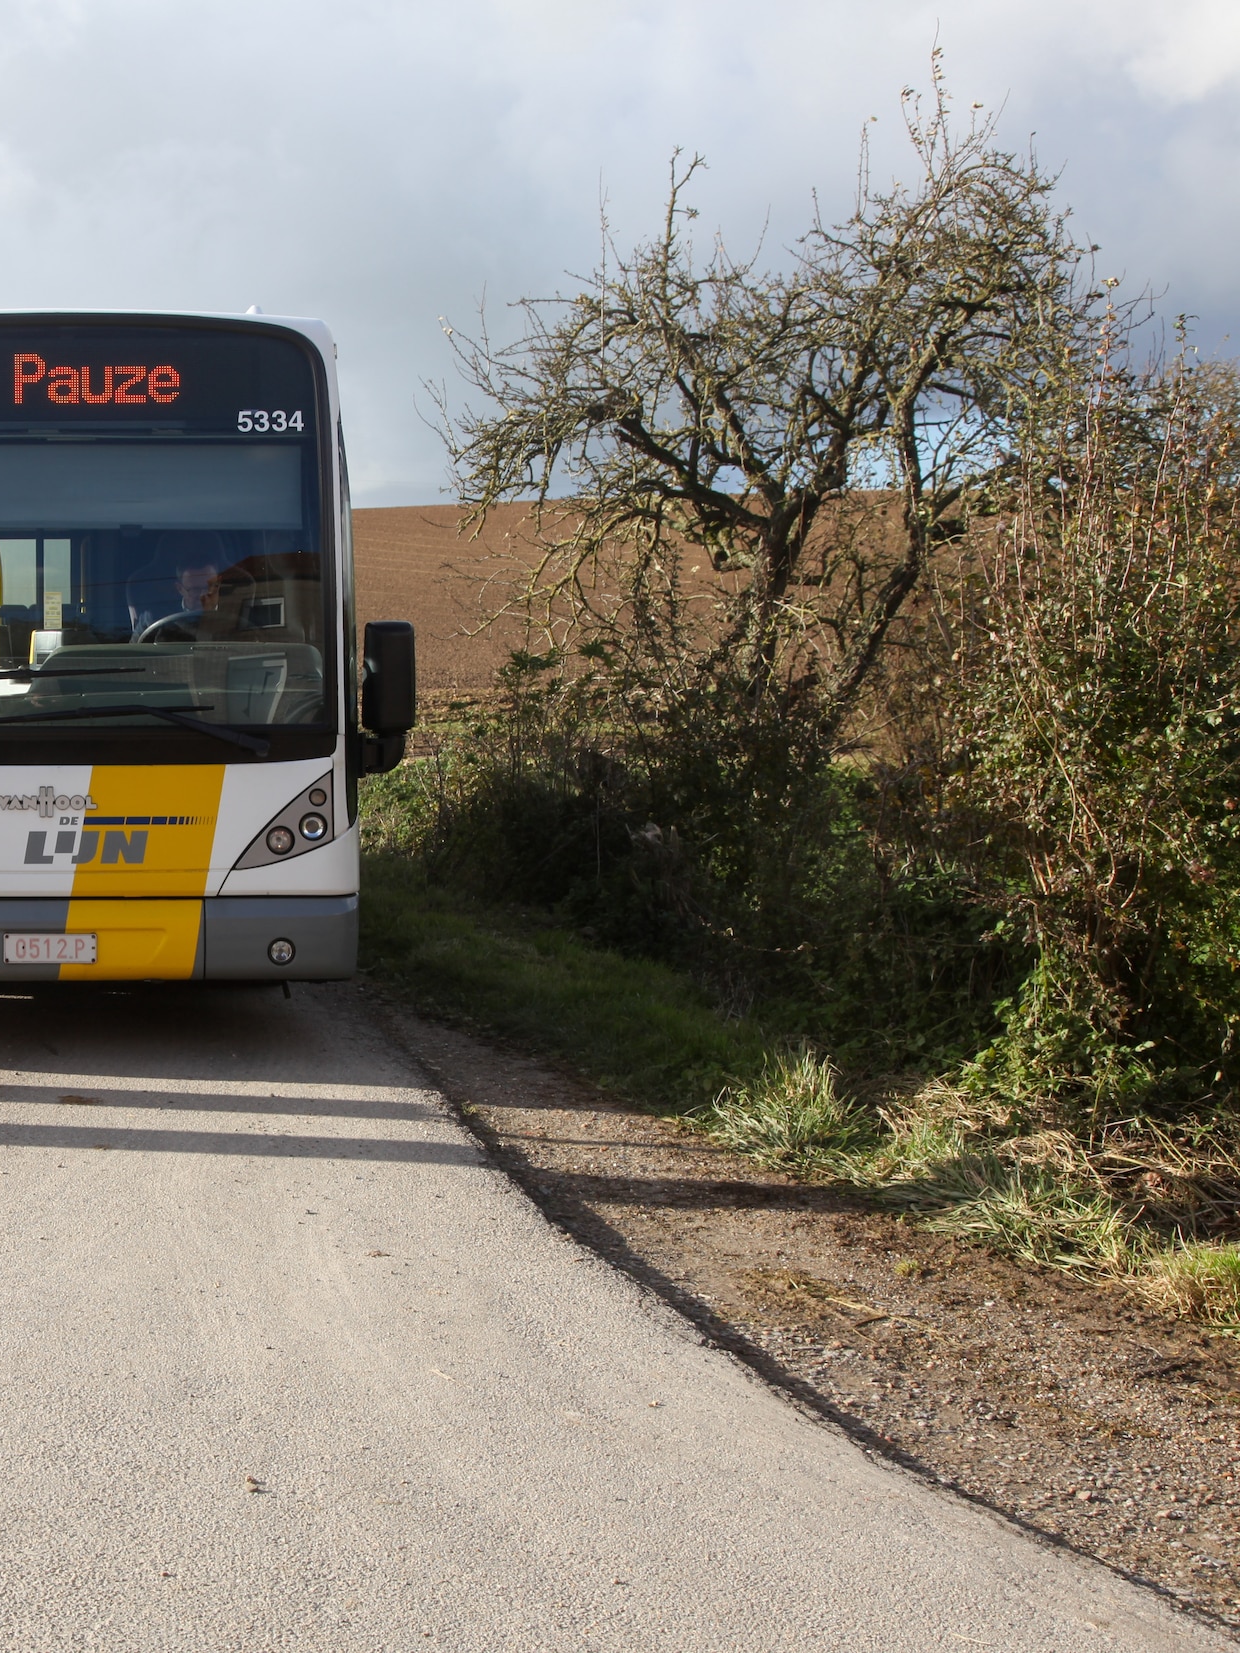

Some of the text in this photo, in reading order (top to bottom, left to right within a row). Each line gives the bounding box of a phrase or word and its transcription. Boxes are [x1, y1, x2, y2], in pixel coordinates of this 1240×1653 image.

[12, 352, 181, 405] Pauze
[236, 409, 306, 433] 5334
[59, 816, 79, 826] DE
[23, 830, 149, 865] LIJN
